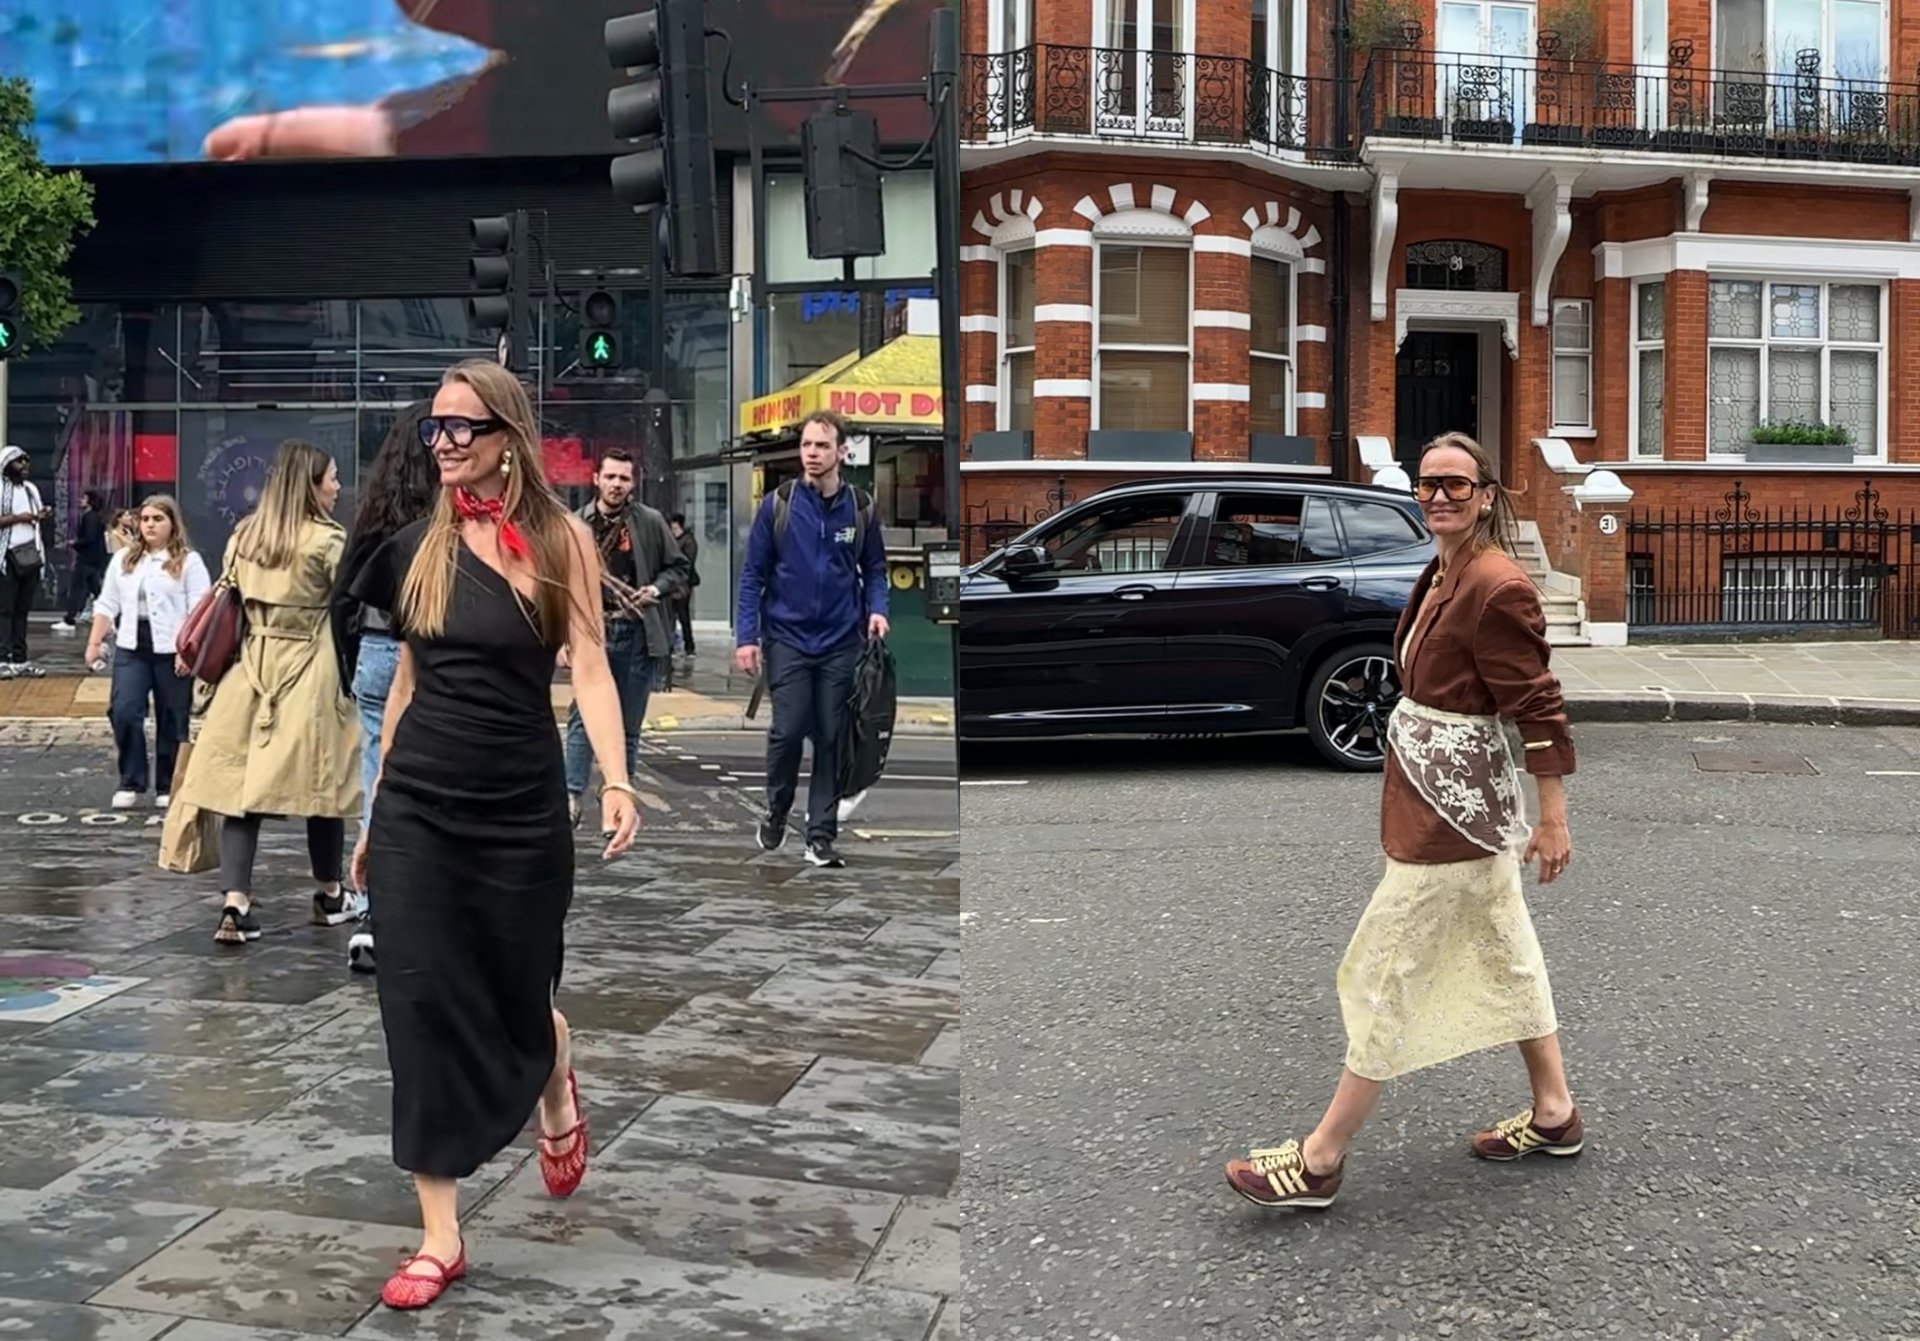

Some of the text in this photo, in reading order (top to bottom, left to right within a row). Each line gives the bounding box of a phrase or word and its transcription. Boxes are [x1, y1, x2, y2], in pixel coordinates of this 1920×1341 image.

[830, 391, 901, 415] HOT
[911, 393, 943, 416] D
[1602, 518, 1614, 530] 31
